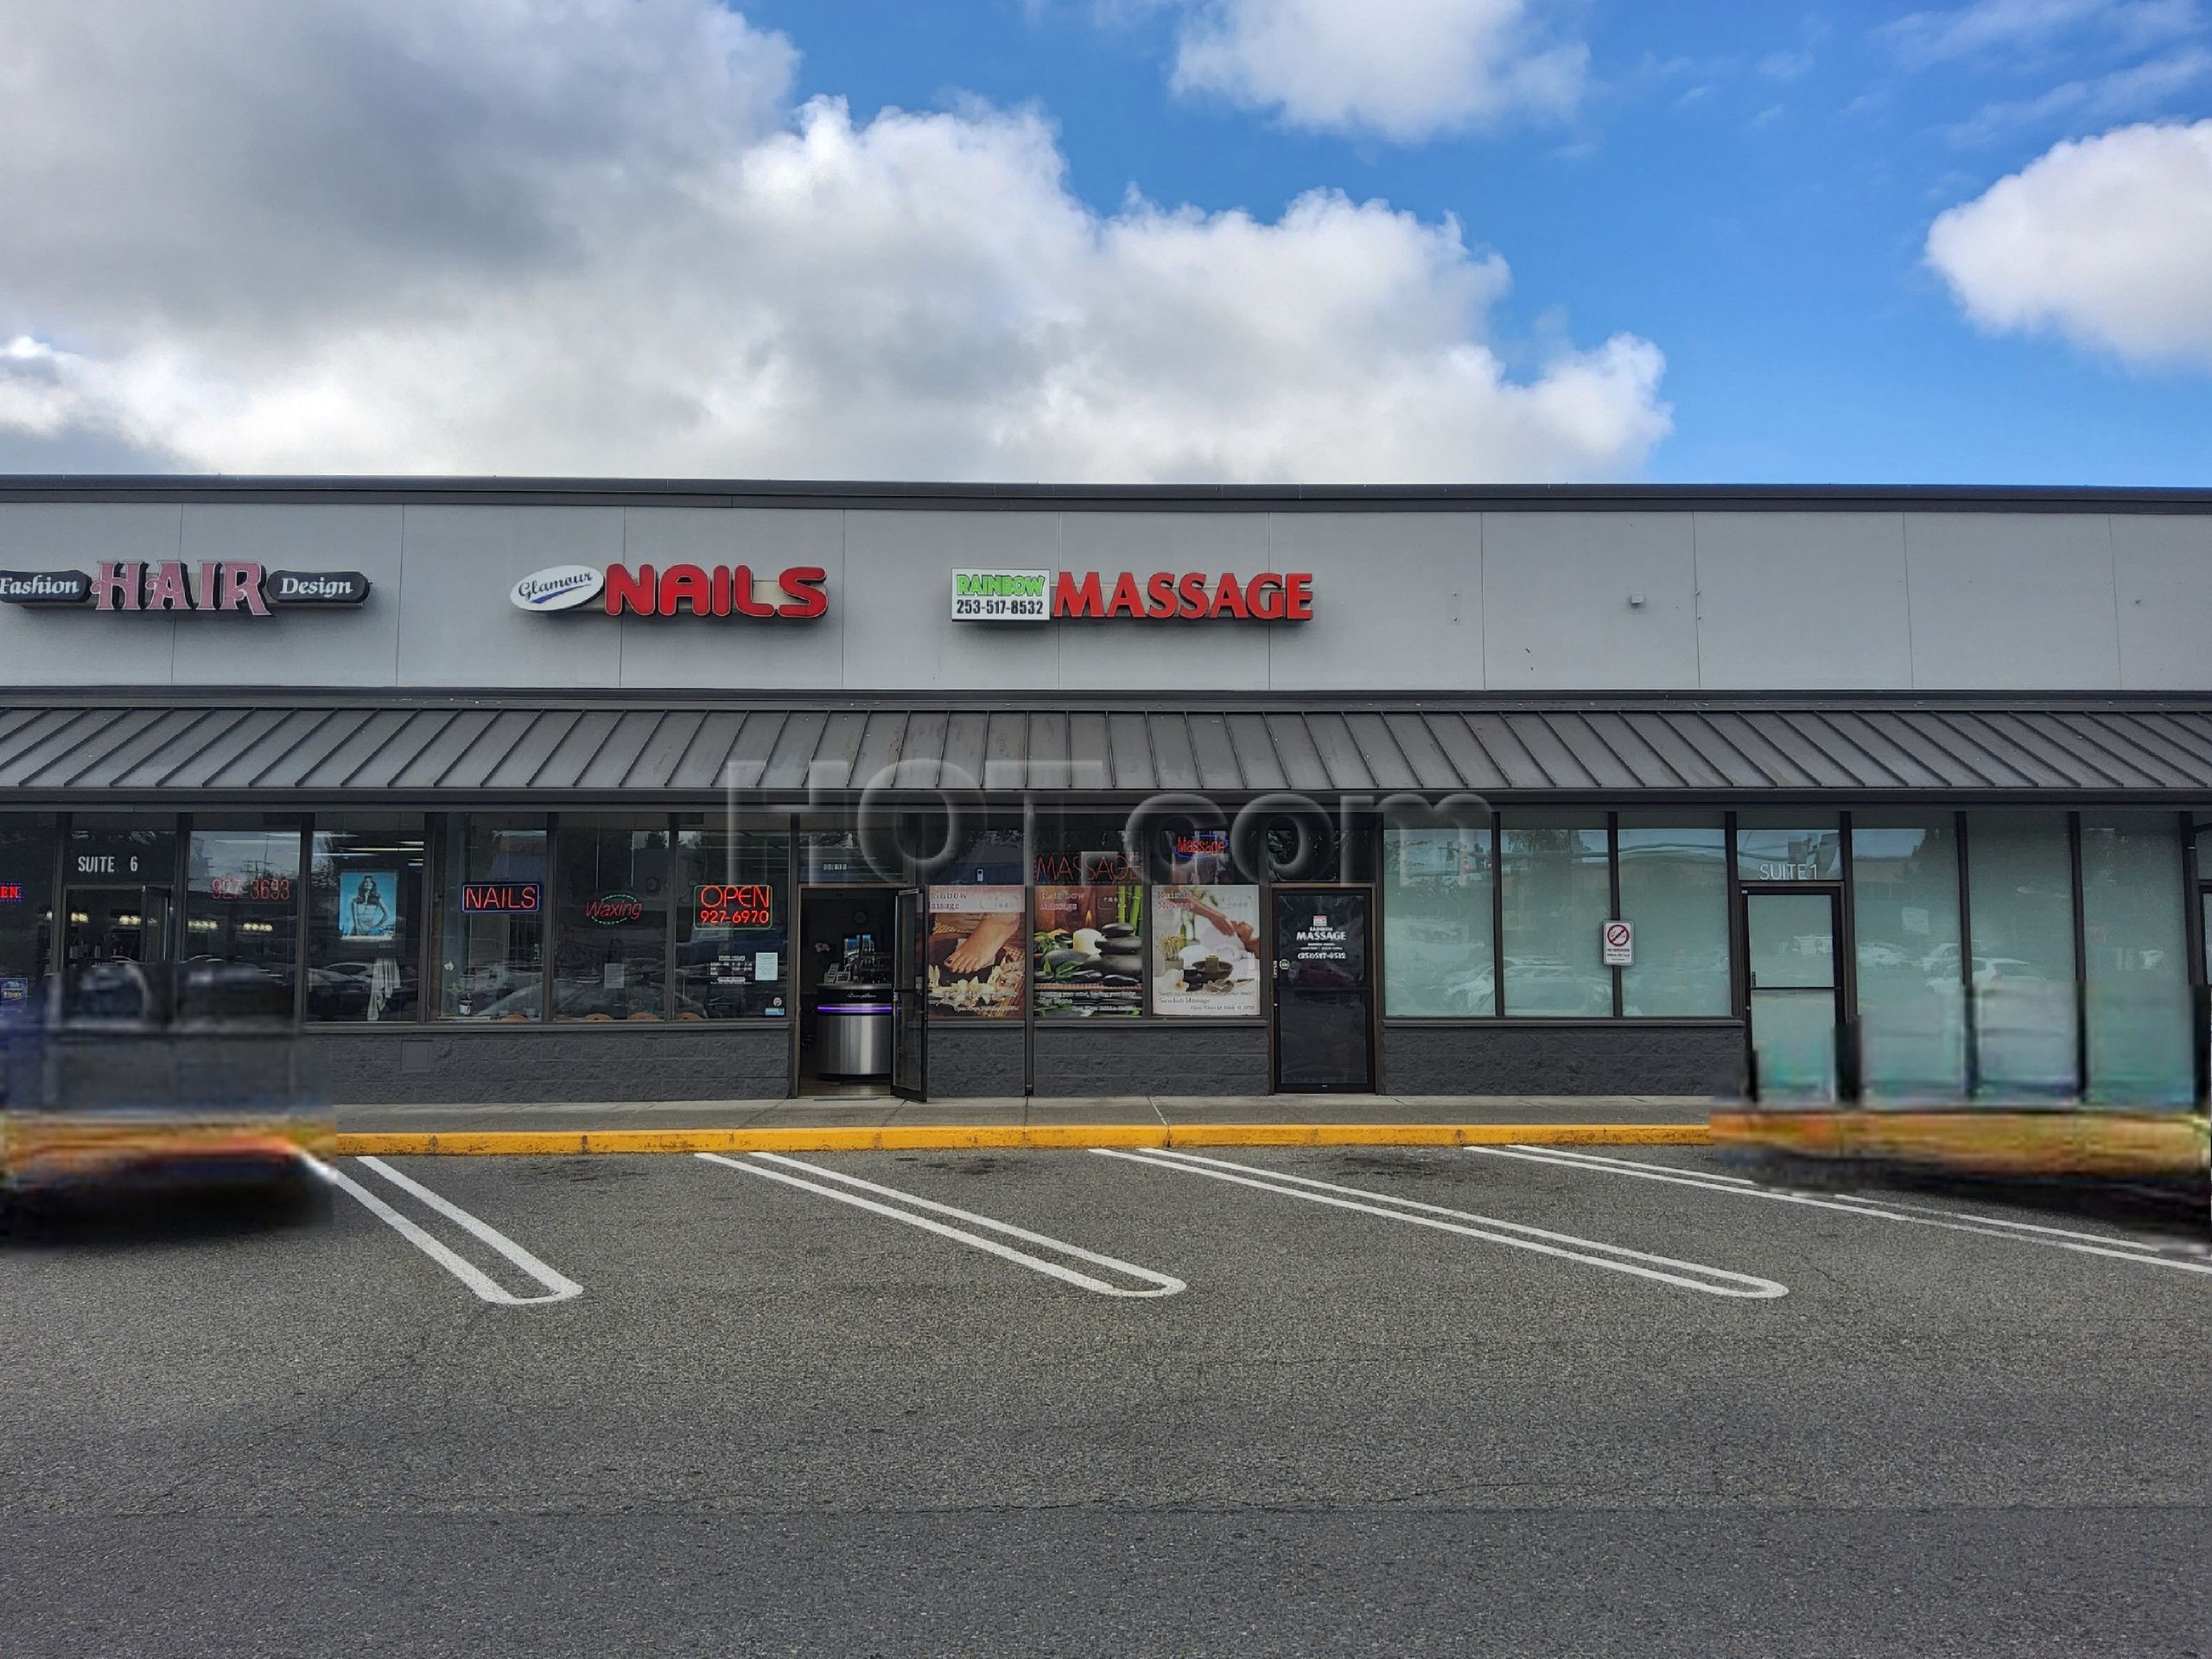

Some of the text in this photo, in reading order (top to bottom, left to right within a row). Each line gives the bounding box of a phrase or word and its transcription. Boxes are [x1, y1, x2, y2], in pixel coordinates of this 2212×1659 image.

[0, 560, 353, 616] Fashion HAIR Design
[518, 563, 829, 618] Glamour NAILS
[957, 574, 1046, 597] RAINBOW
[1053, 571, 1313, 620] MASSAGE
[957, 599, 1044, 615] 253-517-8532
[1177, 836, 1224, 857] Massage
[78, 855, 138, 874] SUITE 6
[1759, 863, 1817, 880] SUITE 1
[465, 886, 536, 910] NAILS
[701, 885, 770, 909] OPEN
[586, 899, 643, 920] Waxing
[700, 910, 769, 925] 927-6970
[1296, 931, 1347, 941] MASSAGE
